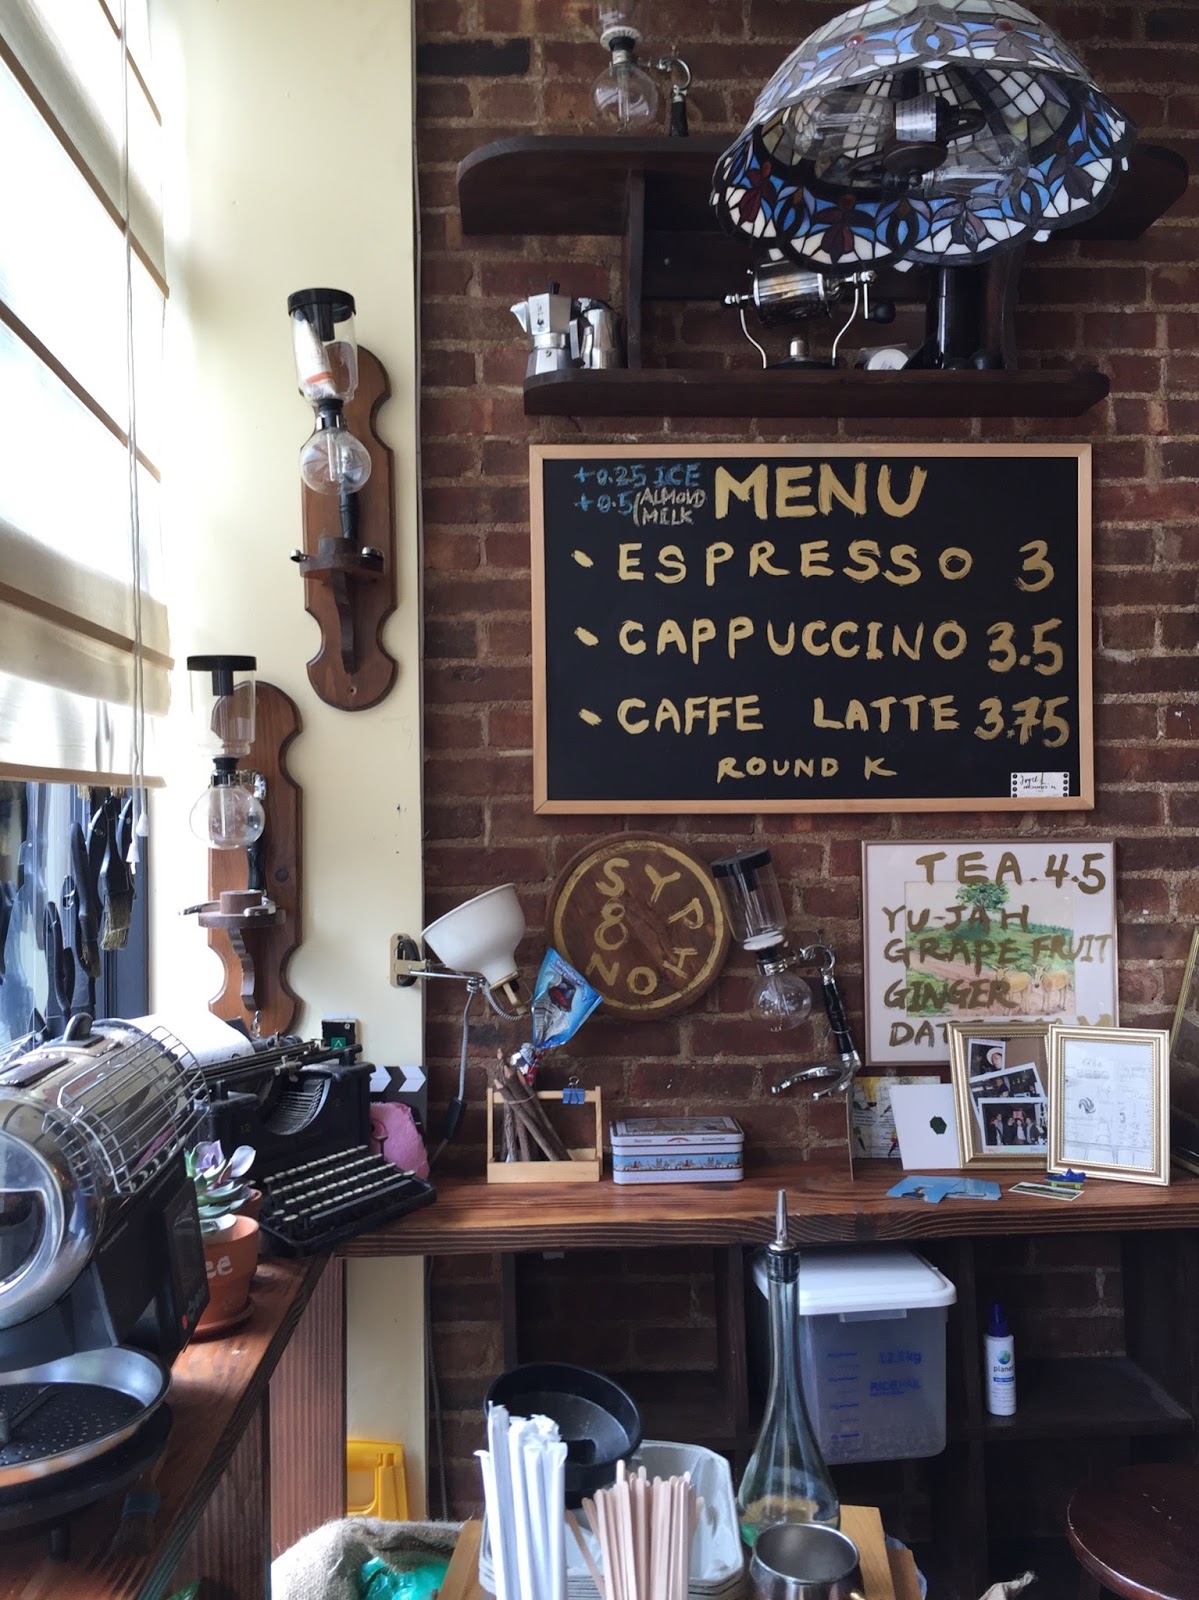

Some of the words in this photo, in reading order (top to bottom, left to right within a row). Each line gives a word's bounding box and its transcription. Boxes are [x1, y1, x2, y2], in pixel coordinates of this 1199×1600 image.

[653, 463, 700, 488] ICE
[715, 462, 927, 520] MENU
[618, 540, 973, 586] ESPRESSO
[1015, 540, 1054, 592] 3
[619, 616, 967, 665] CAPPUCCINO
[987, 618, 1064, 676] 3.5
[617, 695, 764, 735] CAFFE
[813, 695, 960, 733] LATTE
[974, 696, 1070, 748] 3.75
[717, 756, 840, 784] ROUND
[864, 756, 898, 781] K
[882, 904, 1030, 934] YU-JAH
[883, 979, 1018, 1013] GINGER
